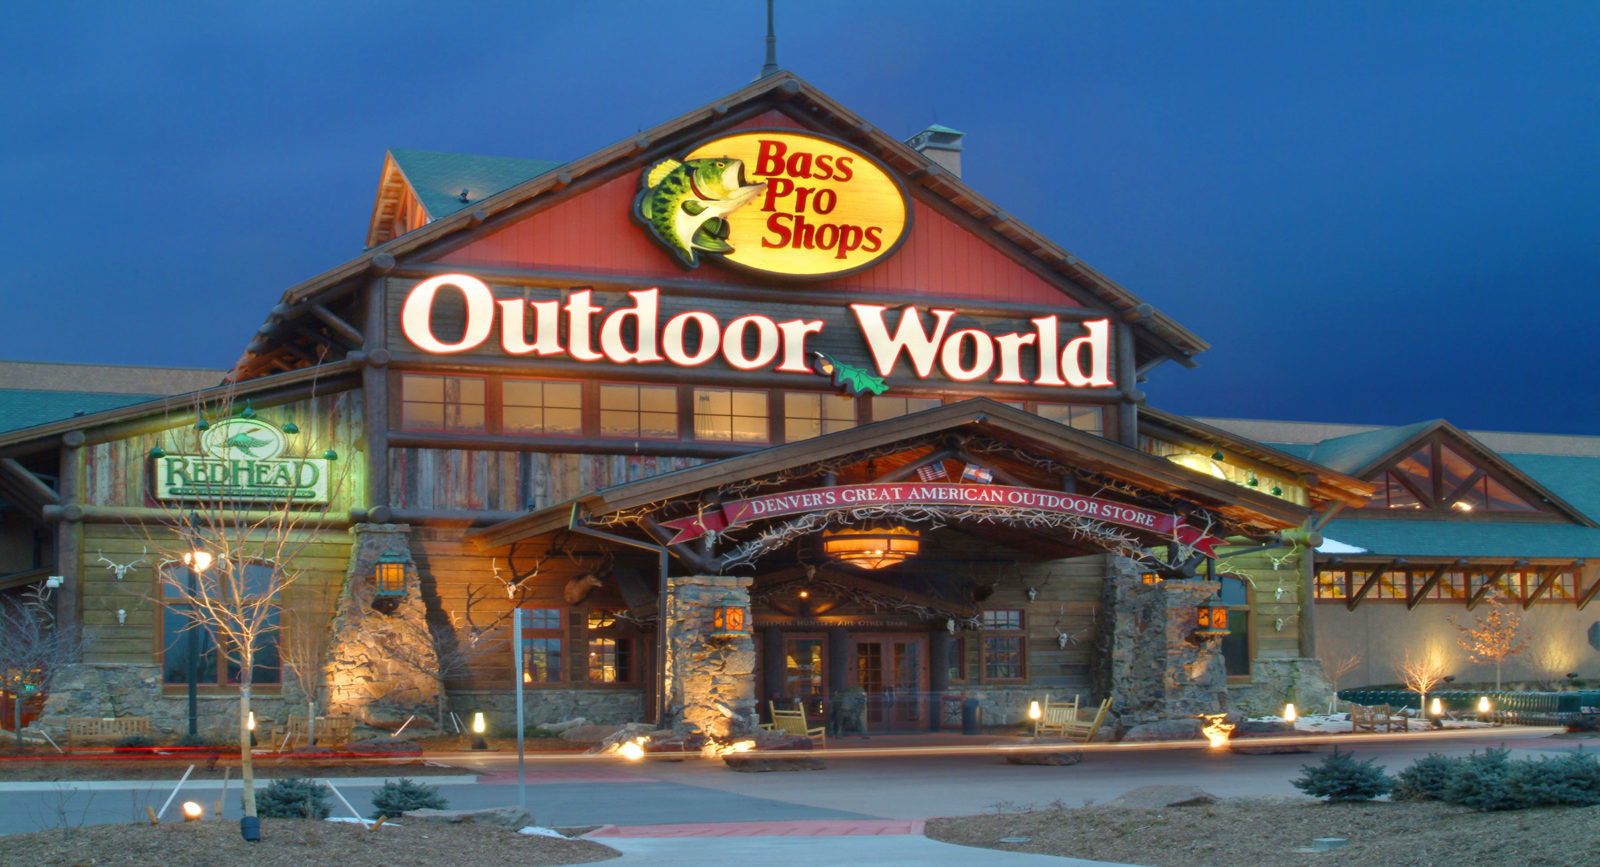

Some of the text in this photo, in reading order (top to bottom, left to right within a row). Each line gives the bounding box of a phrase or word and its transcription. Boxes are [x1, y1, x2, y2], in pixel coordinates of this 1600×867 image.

[752, 140, 854, 182] Bass
[760, 177, 837, 215] Pro
[761, 212, 883, 259] Shops
[401, 273, 1115, 388] Outdoor World
[751, 487, 1156, 528] DENVER'S GREAT AMERICAN OUTDOOR STORE
